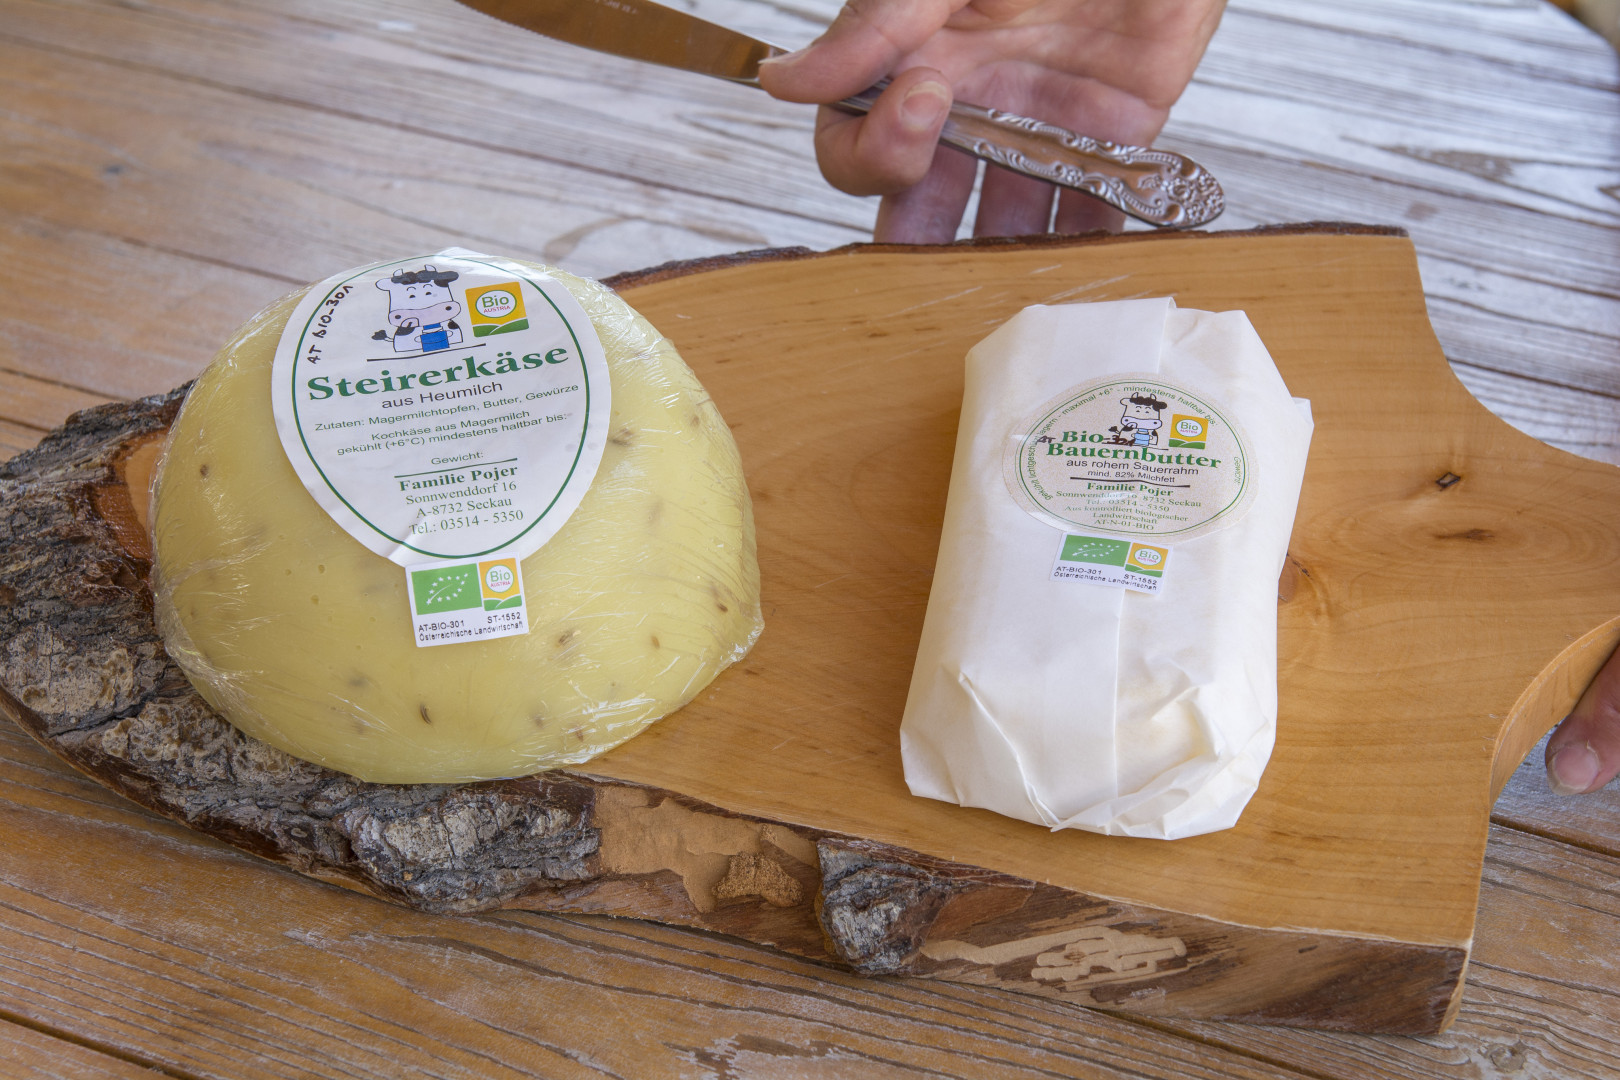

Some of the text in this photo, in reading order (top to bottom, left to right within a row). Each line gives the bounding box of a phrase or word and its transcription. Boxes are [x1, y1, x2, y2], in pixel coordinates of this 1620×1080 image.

[482, 295, 509, 308] Bio
[483, 305, 511, 313] AUSTRIA
[307, 344, 322, 364] AT
[307, 348, 569, 400] Steirerkäse
[382, 381, 503, 408] aus Heumilch
[1062, 394, 1096, 415] maximal
[1123, 386, 1175, 400] mindestens
[1178, 397, 1205, 414] haltbar
[315, 385, 579, 431] Zutaten: Magermilchtopfen, Butter, Gewürze
[371, 410, 530, 441] Kochkäse aus Magermilch
[1180, 421, 1199, 431] Bio
[337, 413, 567, 455] gekühlt (+6°C) mindestens haltbar bis:
[1061, 431, 1104, 443] Bio
[431, 451, 484, 465] Gewicht:
[1046, 443, 1221, 468] Bauernbutter
[1091, 460, 1129, 470] rohem
[1133, 462, 1199, 475] Sauerrahm
[399, 466, 518, 491] Familie Pojer
[1138, 472, 1175, 482] Milchfett
[406, 481, 517, 505] Sonnwenddorf 16
[1087, 482, 1174, 496] Familie Pojer
[416, 498, 512, 518] A-8732 Seckau
[1143, 495, 1165, 504] 8732
[1168, 498, 1202, 507] Seckau
[1147, 503, 1170, 512] 5350
[1084, 505, 1132, 513] kontrolliert
[1135, 508, 1189, 521] biologischer
[1093, 512, 1157, 525] Landwirtschaft
[408, 521, 437, 535] Tel.:
[440, 515, 480, 530] 03514
[493, 510, 524, 523] 5350
[1094, 519, 1154, 530] AT-N-01-BIO
[1140, 550, 1159, 561] Bio
[490, 570, 510, 582] Bio
[1053, 571, 1106, 582] Österreichische
[1056, 566, 1158, 585] AT-BIO-301 ST-1552
[418, 612, 521, 632] AT-BIO-301 ST-1552
[419, 621, 523, 641] Österreichische Landwirtschaft
